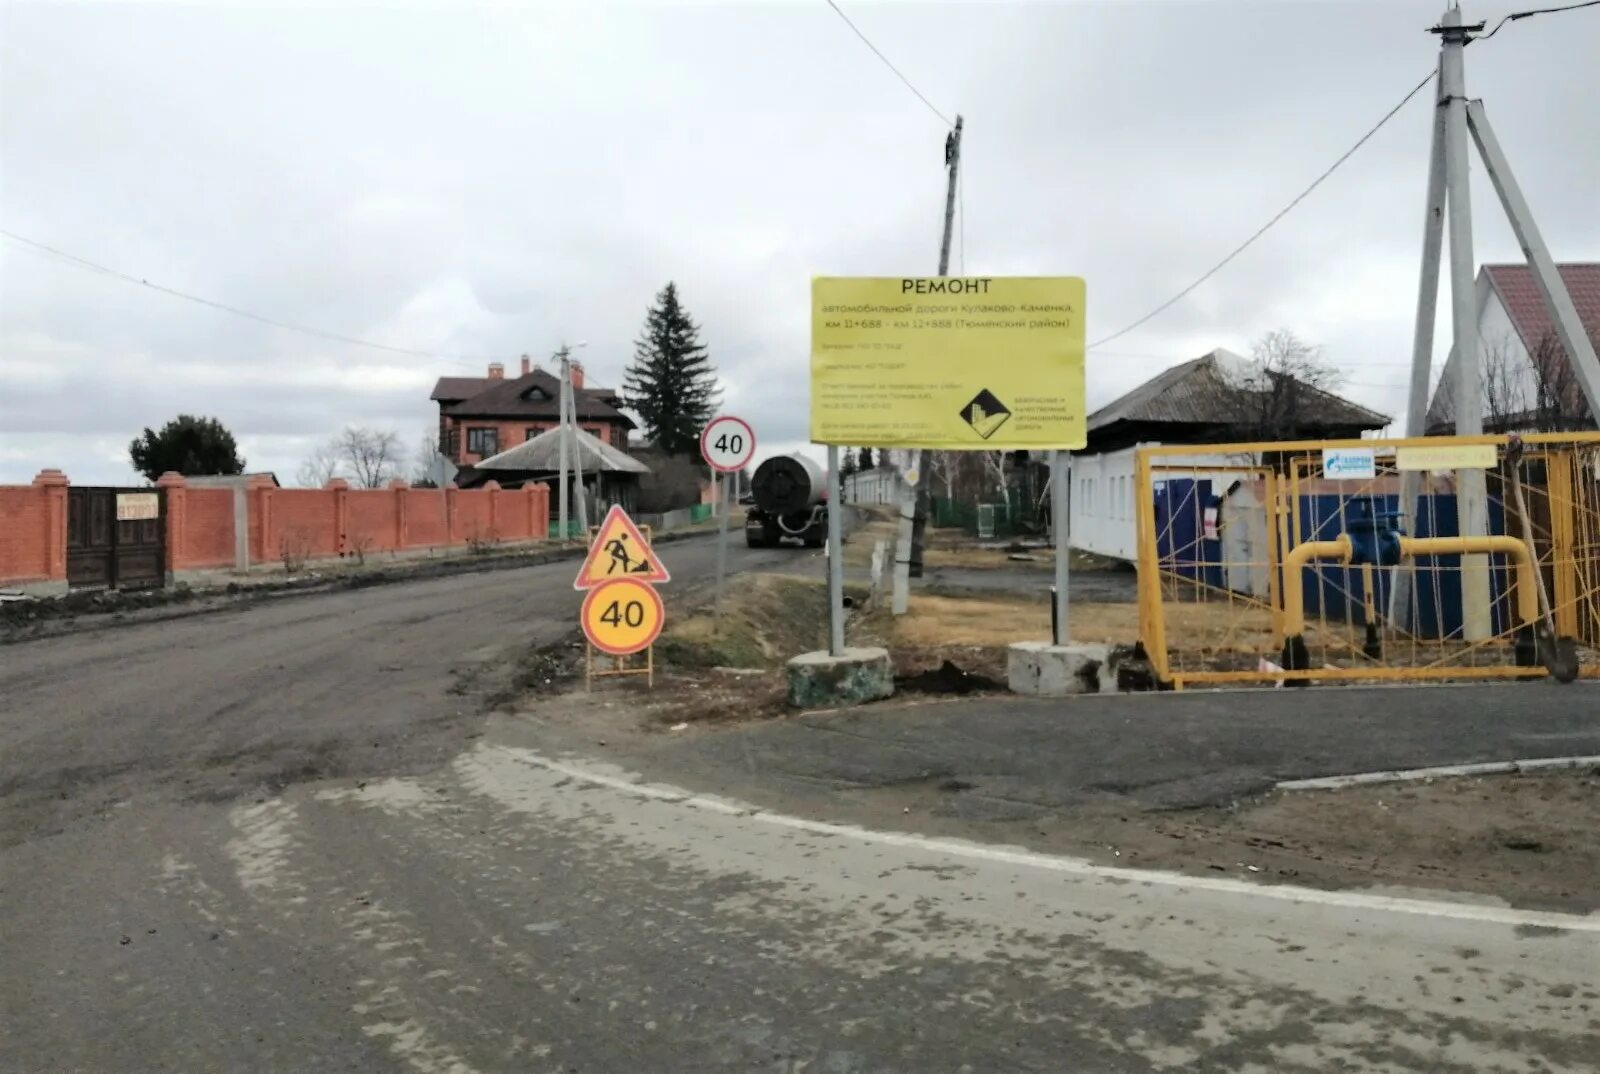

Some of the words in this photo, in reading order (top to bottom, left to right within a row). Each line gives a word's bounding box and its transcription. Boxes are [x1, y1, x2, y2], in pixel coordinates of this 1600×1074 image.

[901, 279, 993, 294] РЕМОНТ
[821, 302, 913, 314] автомобильной
[915, 304, 957, 316] дороги
[824, 320, 841, 329] км
[893, 320, 910, 329] км
[955, 318, 1026, 331] (Тюменский
[1028, 319, 1071, 330] район)
[715, 433, 743, 454] 40
[599, 600, 645, 629] 40
